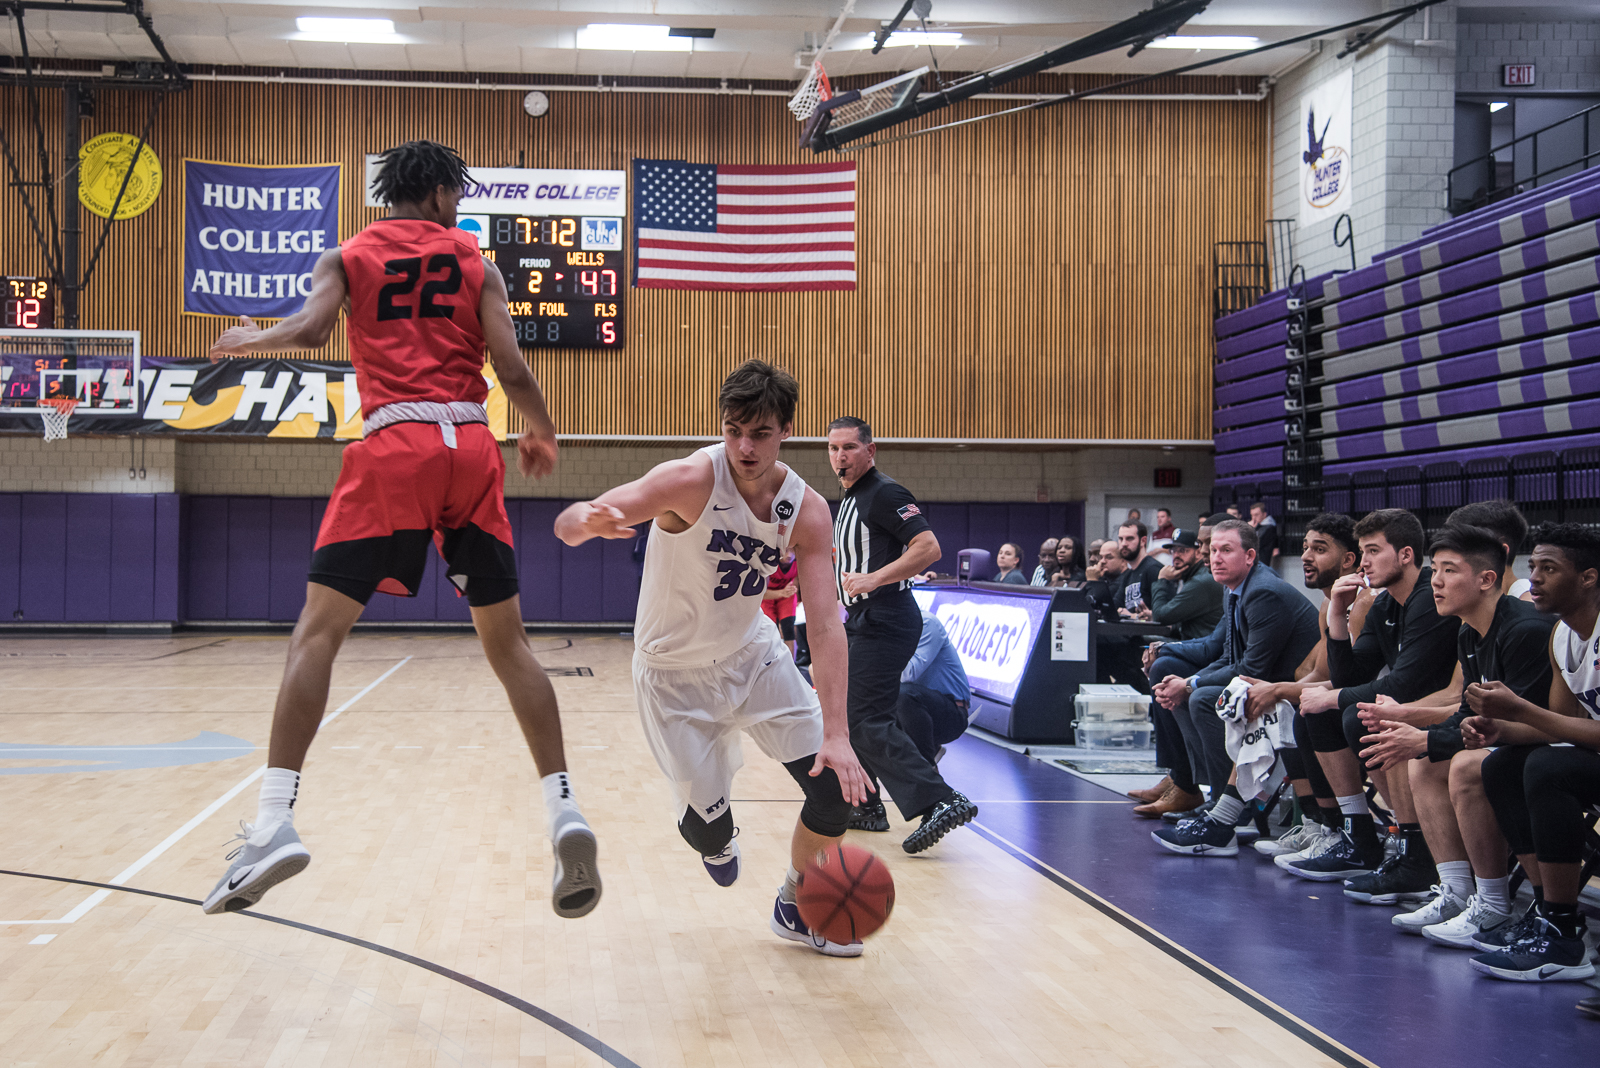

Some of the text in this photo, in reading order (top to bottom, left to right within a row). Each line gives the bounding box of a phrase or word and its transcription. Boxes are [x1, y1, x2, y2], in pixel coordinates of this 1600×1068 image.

[1509, 66, 1532, 84] EXIT
[1314, 159, 1341, 184] HUNTER
[203, 183, 323, 211] HUNTER
[464, 183, 620, 200] UNTER COLLEGE
[199, 226, 325, 253] COLLEGE
[516, 218, 576, 247] 7:12
[519, 258, 551, 268] PERIOD
[566, 251, 605, 266] WELLS
[10, 280, 48, 299] 7:12
[191, 268, 313, 298] ATHLETIC
[377, 253, 462, 321] 22
[527, 270, 543, 294] 2
[580, 269, 617, 296] 47
[16, 298, 40, 329] 12
[539, 302, 569, 317] FOUL
[594, 303, 617, 317] FLS
[601, 321, 616, 344] 5
[777, 505, 793, 516] Cal
[714, 559, 766, 601] 30
[956, 614, 1027, 667] VIOLETS!
